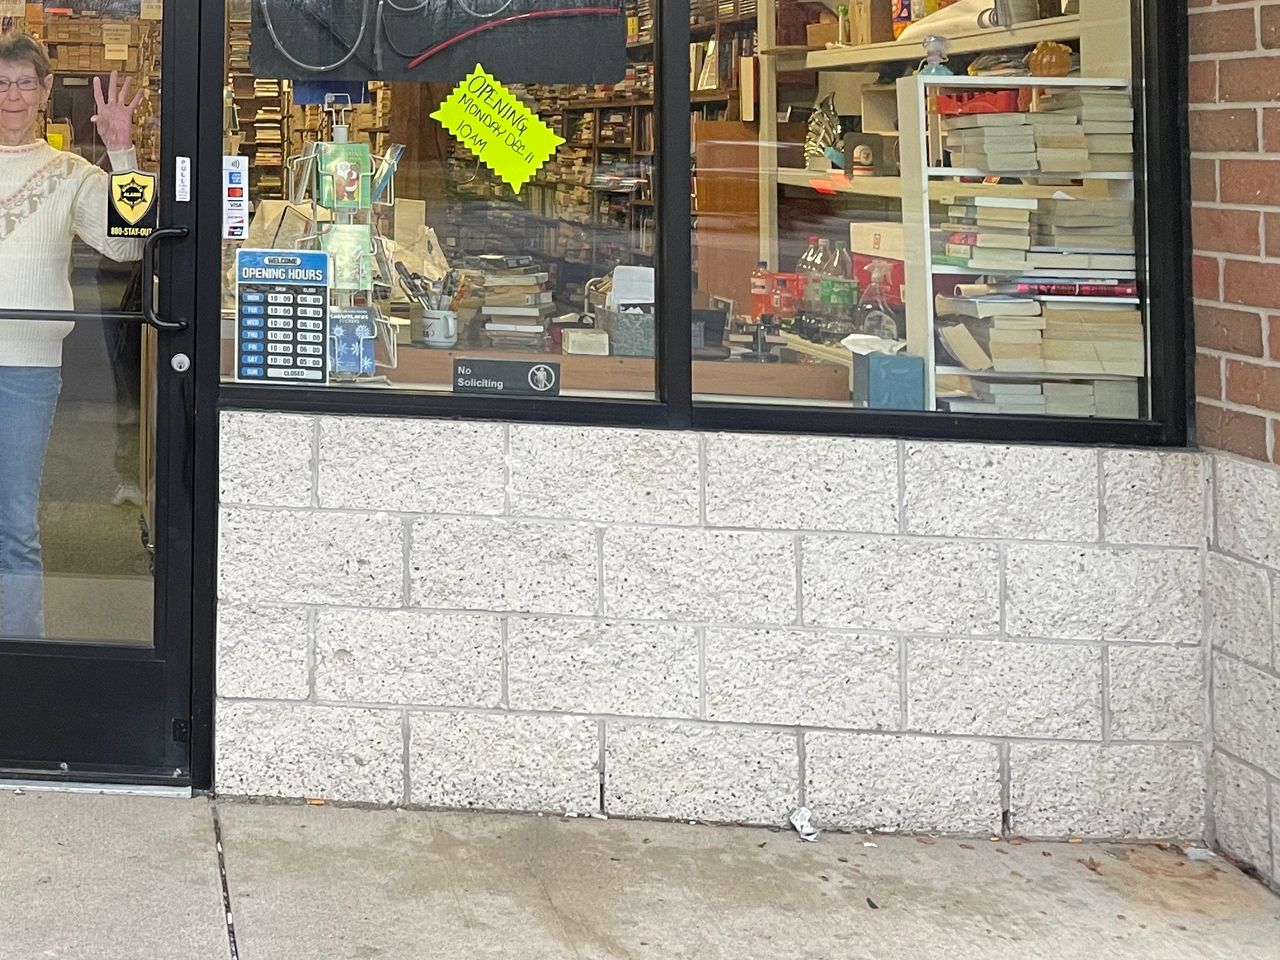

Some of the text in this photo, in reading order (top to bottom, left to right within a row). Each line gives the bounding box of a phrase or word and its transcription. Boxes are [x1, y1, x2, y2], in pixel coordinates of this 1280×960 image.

[467, 75, 529, 137] OPENING
[458, 93, 507, 138] MONDAY
[504, 132, 526, 156] DEC
[456, 119, 488, 152] 10AM
[267, 257, 298, 265] WELCOME
[242, 267, 323, 281] OPENING HOURS
[283, 369, 304, 377] CLOSED
[457, 366, 472, 375] No
[457, 378, 504, 390] Soliciting
